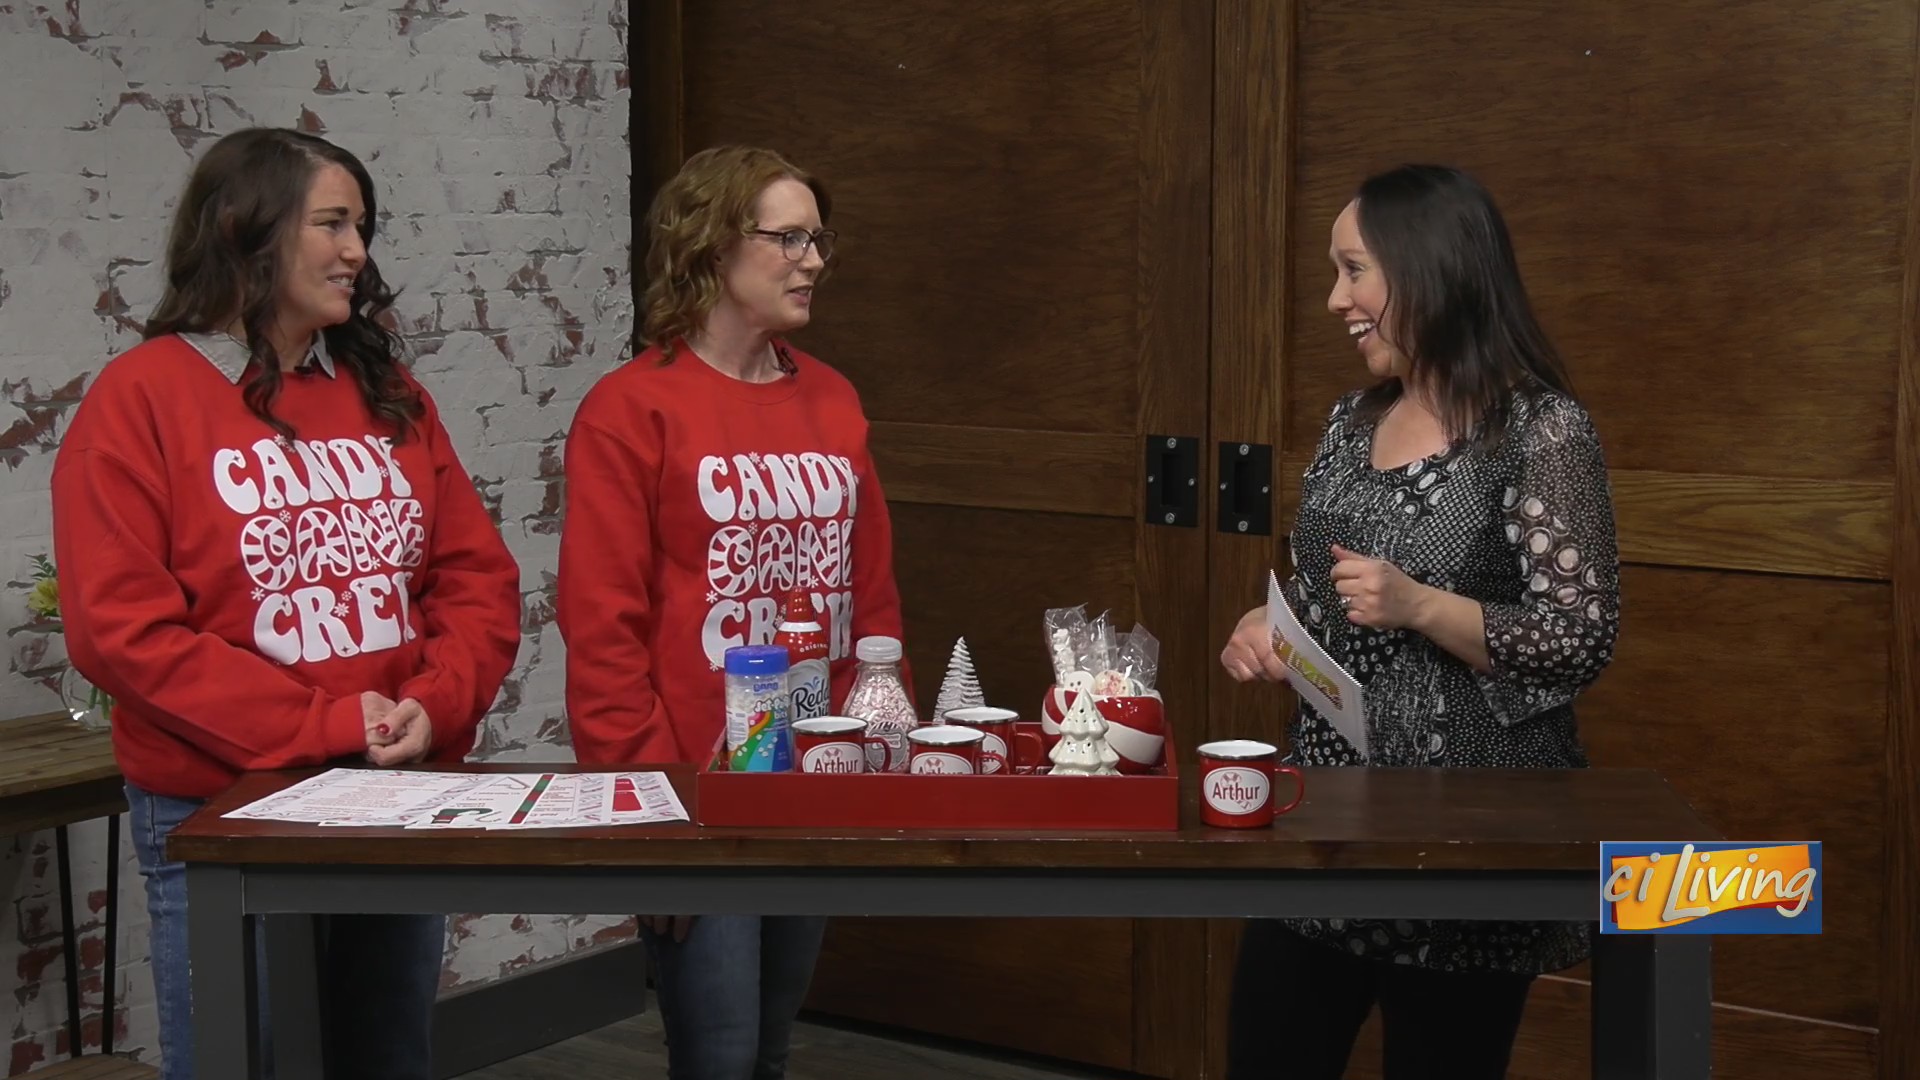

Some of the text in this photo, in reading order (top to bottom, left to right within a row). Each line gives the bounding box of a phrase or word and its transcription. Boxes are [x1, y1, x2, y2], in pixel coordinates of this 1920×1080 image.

[214, 435, 412, 514] CANDY
[698, 452, 857, 522] CANDY
[241, 499, 424, 590] CANE
[814, 757, 858, 773] Arthur
[1212, 782, 1260, 800] Arthur
